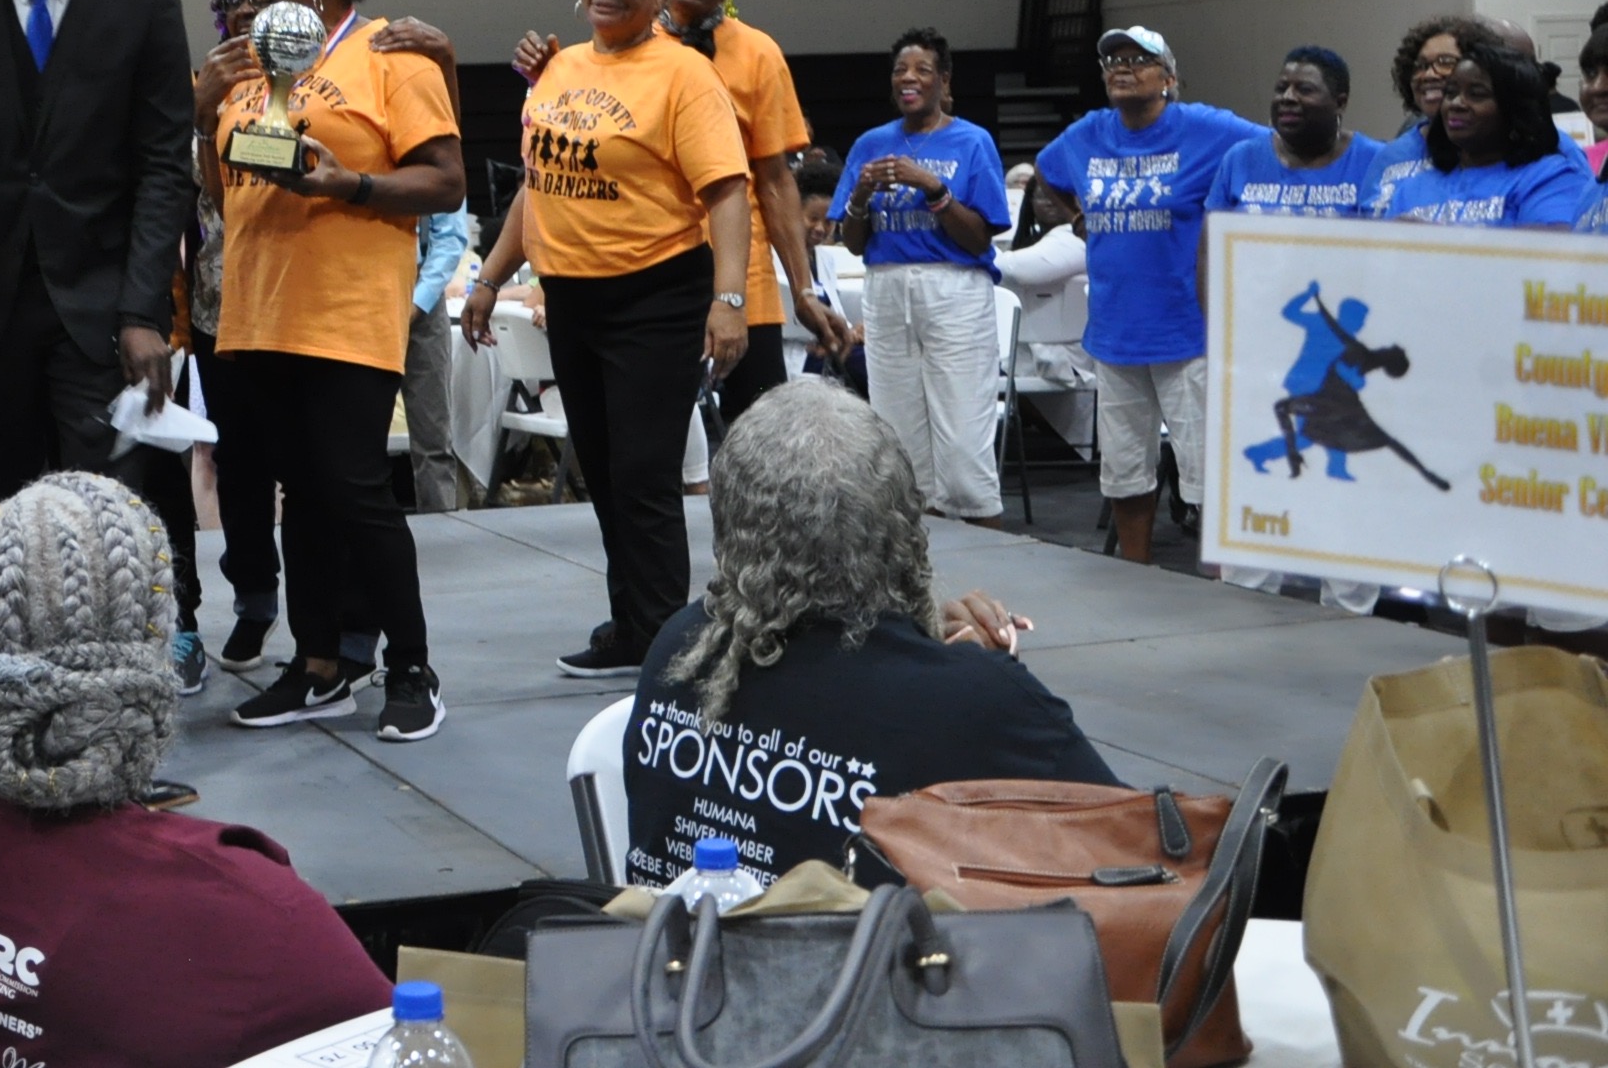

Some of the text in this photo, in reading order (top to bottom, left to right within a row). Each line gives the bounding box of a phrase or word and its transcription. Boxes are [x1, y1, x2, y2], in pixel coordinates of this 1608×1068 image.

[584, 88, 637, 132] COUNTY
[543, 172, 620, 202] DANCERS
[1494, 401, 1579, 452] Buena
[1479, 462, 1570, 515] Senior
[665, 699, 844, 771] thank you to all of our
[637, 716, 878, 833] SPONSORS
[693, 797, 757, 834] HUMANA
